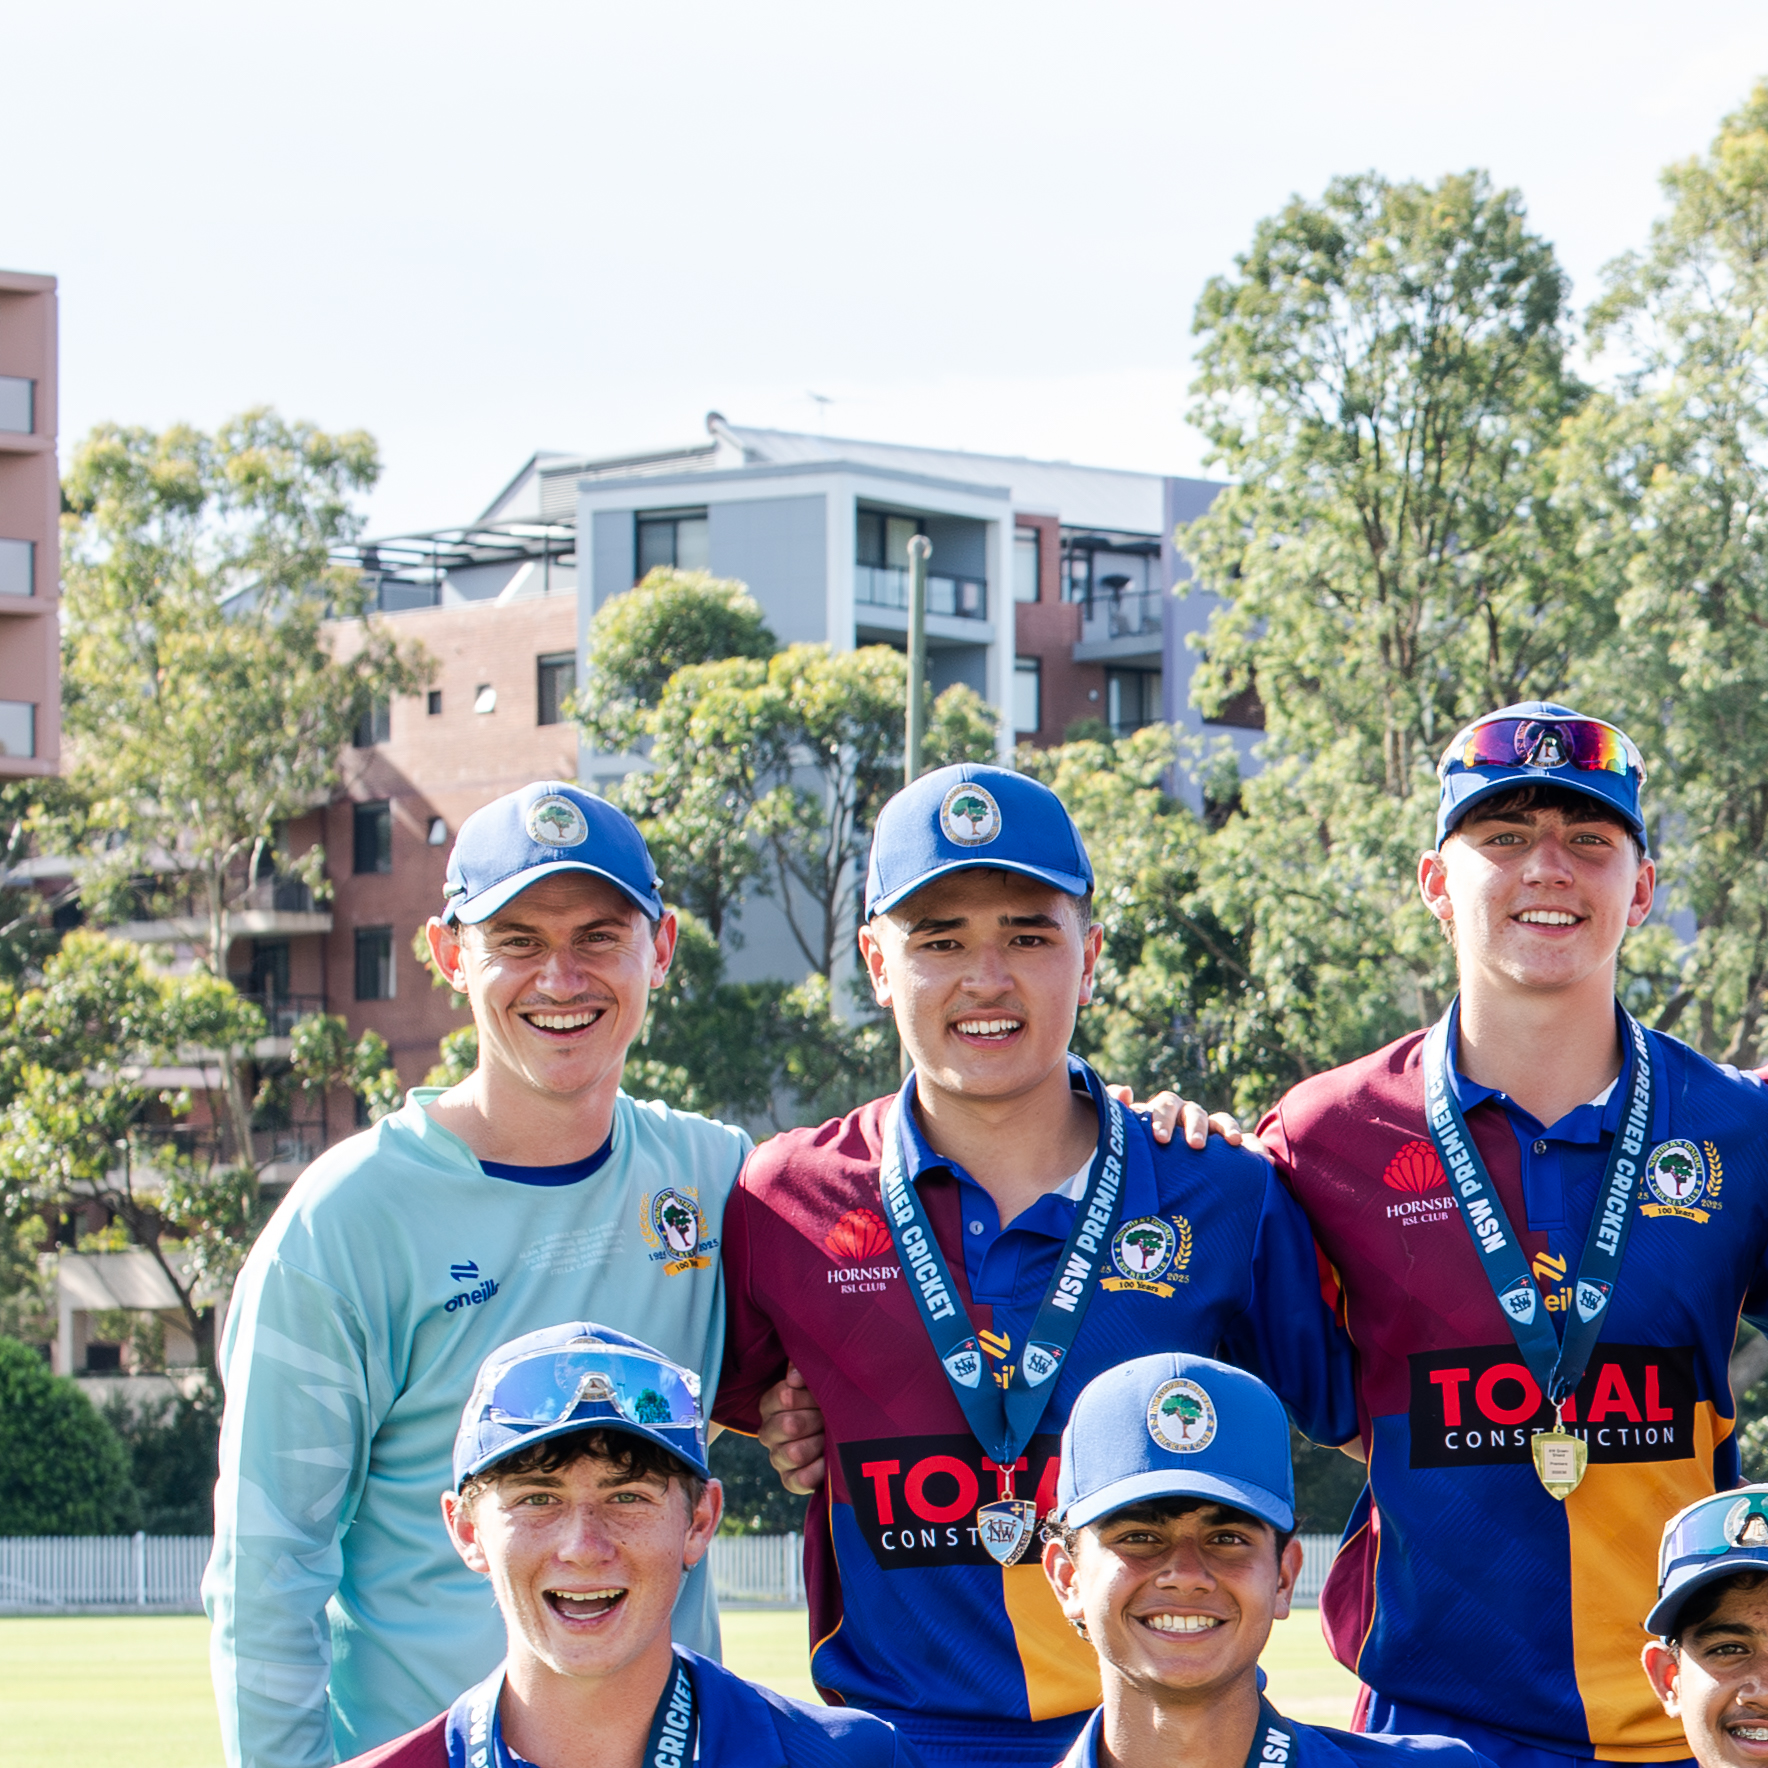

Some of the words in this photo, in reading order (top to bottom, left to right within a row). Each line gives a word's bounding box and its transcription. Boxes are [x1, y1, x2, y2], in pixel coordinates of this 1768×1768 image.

[1625, 1061, 1652, 1158] PREMIER
[1430, 1103, 1485, 1200] PREMIER
[1387, 1195, 1460, 1219] HORNSBY
[1403, 1215, 1419, 1227] RSL
[1421, 1211, 1449, 1223] CLUB
[1467, 1199, 1507, 1254] NSW
[1596, 1157, 1638, 1257] CRICKET
[1657, 1206, 1674, 1216] 100
[1675, 1207, 1697, 1220] Years
[1052, 1252, 1092, 1313] NSW
[1076, 1155, 1123, 1253] PREMIER
[827, 1266, 901, 1284] HORNSBY
[841, 1283, 857, 1294] RSL
[859, 1282, 887, 1293] CLUB
[901, 1225, 956, 1321] CRICKET
[1119, 1280, 1135, 1289] 100
[1136, 1281, 1159, 1293] Years
